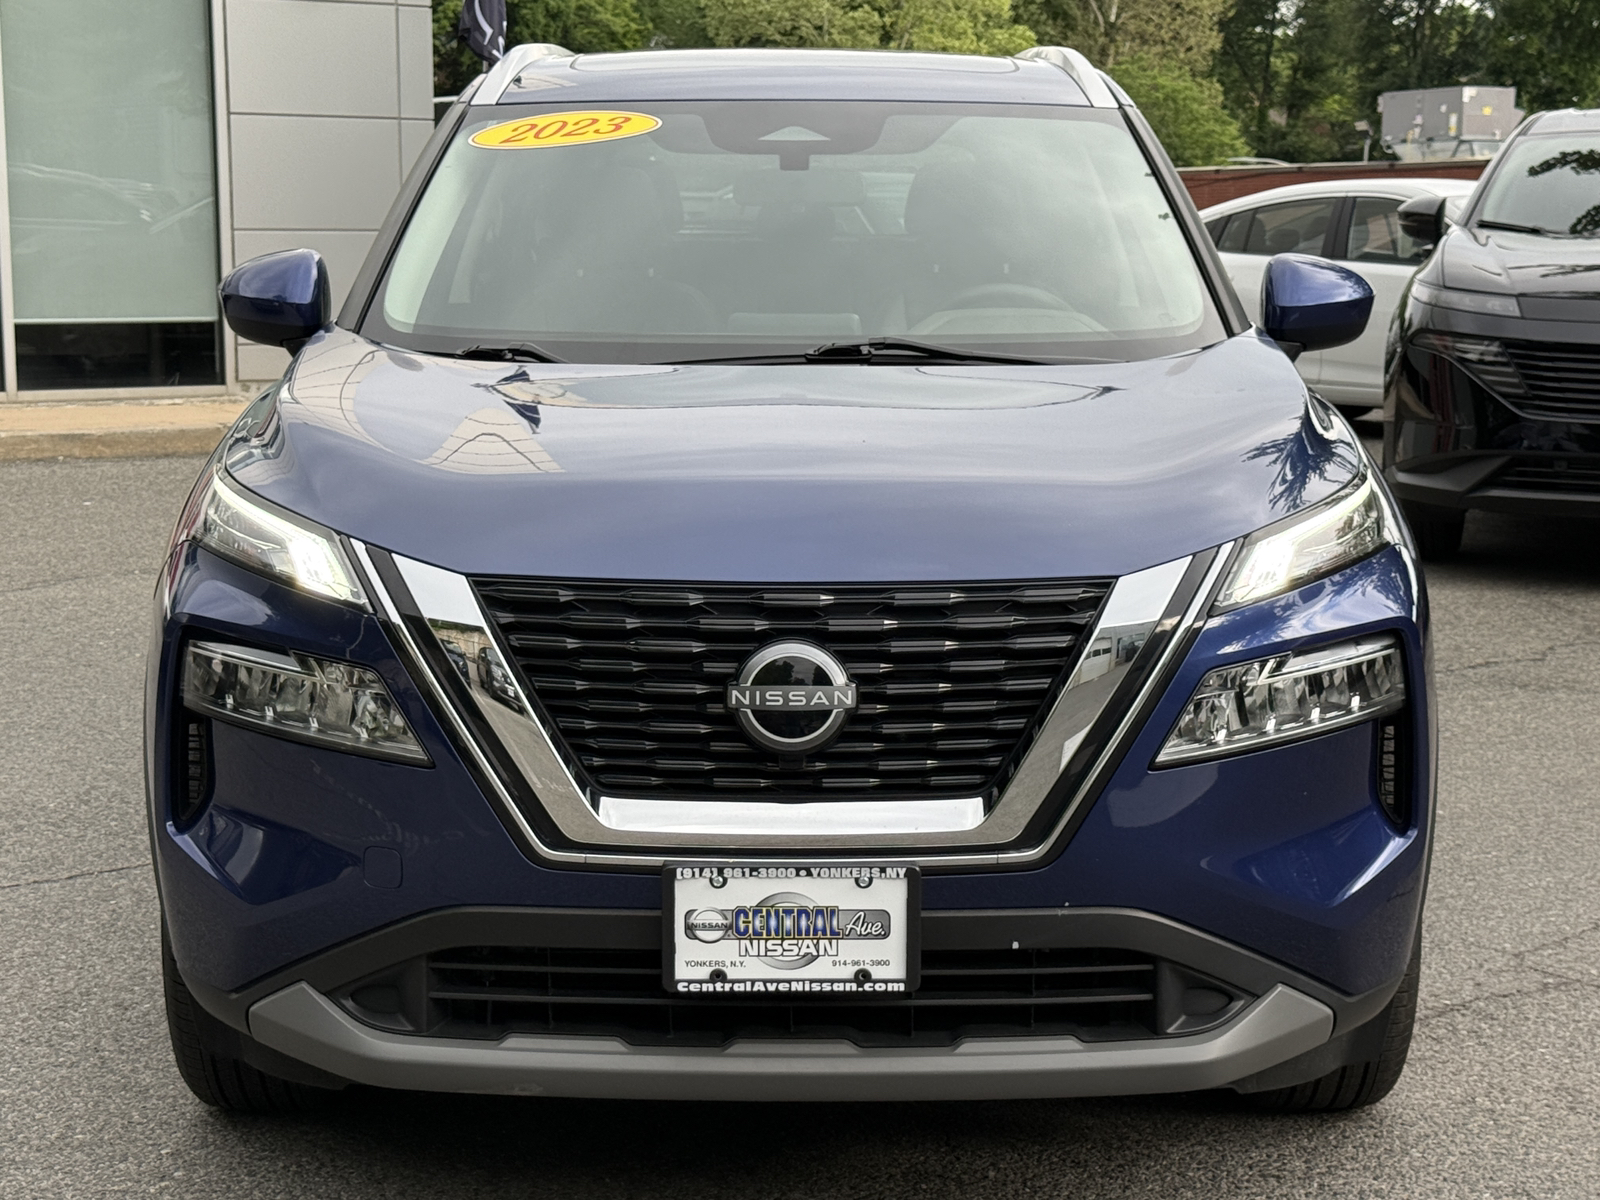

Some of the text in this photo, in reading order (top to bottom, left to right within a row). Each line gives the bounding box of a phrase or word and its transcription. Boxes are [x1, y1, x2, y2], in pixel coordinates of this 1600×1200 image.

[499, 116, 632, 144] 2023
[731, 690, 852, 706] NISSAN
[723, 867, 796, 878] 961-3900
[733, 906, 843, 938] CENTRAL
[845, 911, 886, 936] Ave.
[739, 939, 838, 957] NISSAN
[684, 960, 746, 968] YONKERS, N.Y.
[832, 959, 891, 967] 914-961-3900
[677, 981, 905, 992] CentralAveNissan.com
